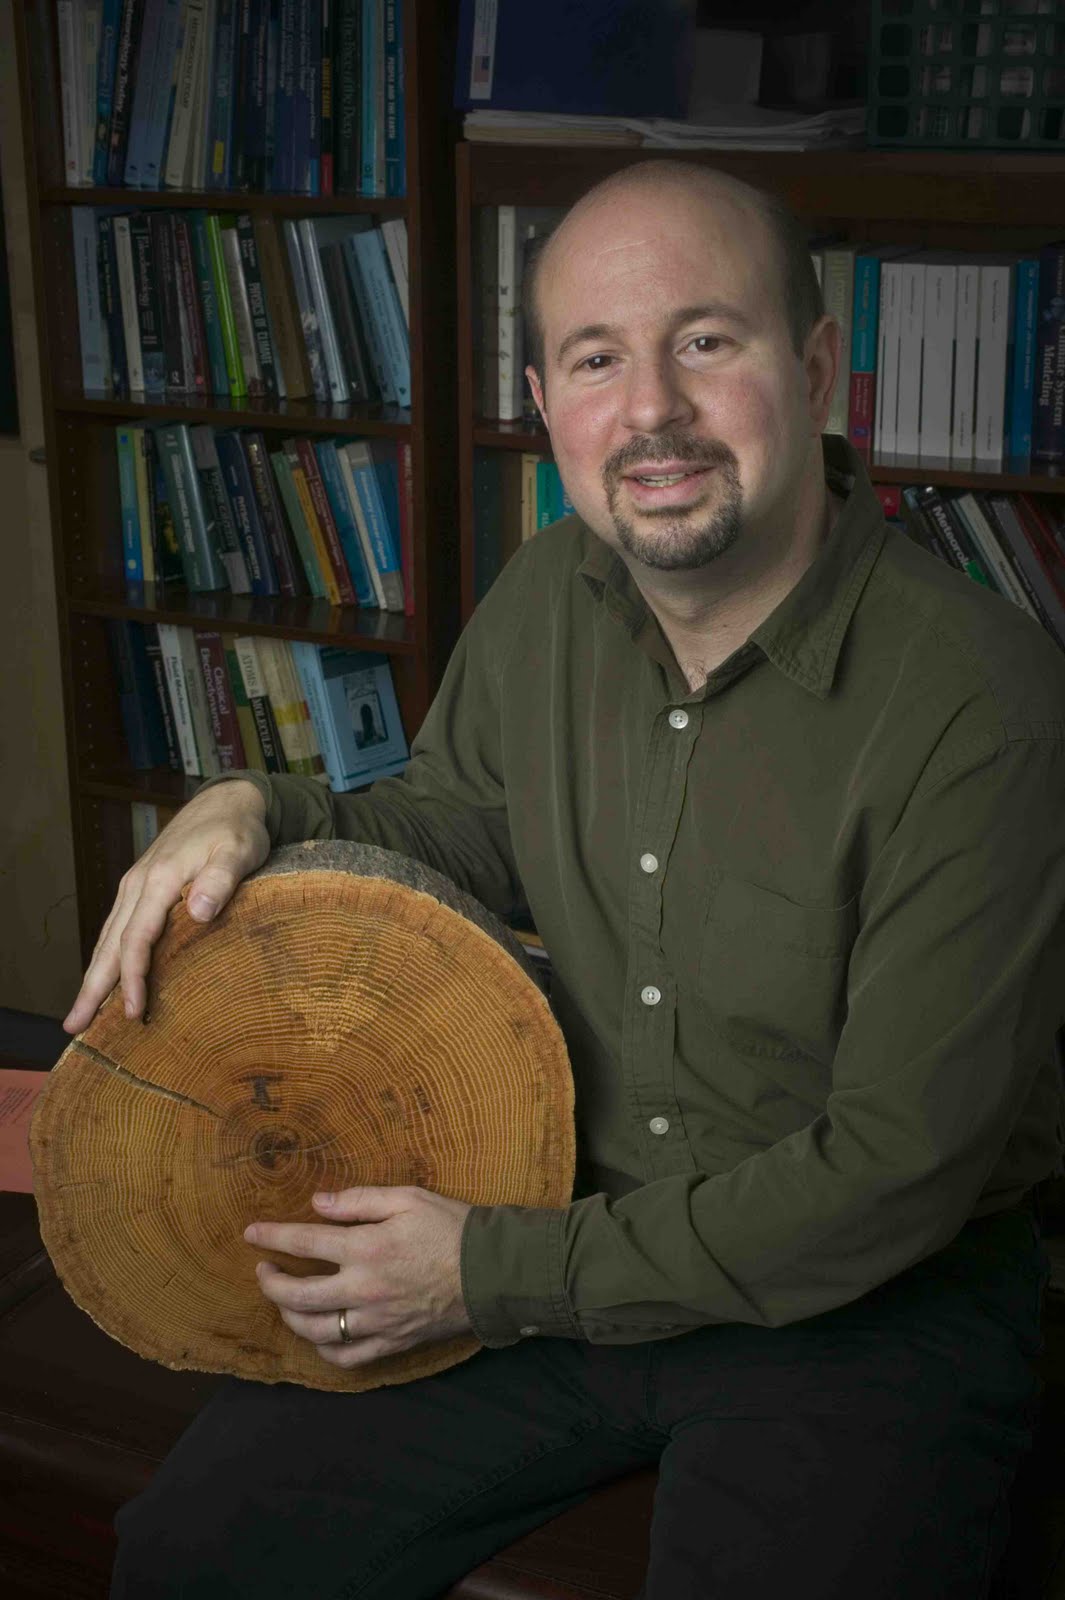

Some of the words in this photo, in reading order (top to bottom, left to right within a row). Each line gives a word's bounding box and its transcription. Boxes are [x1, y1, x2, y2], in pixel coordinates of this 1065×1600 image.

[118, 0, 136, 71] eteorology
[248, 282, 266, 316] PHYSICS
[256, 331, 273, 365] CLIMATE
[1037, 344, 1055, 407] Modeling
[1052, 379, 1065, 427] System
[200, 647, 222, 737] Electrodynamics
[213, 667, 230, 715] Classical
[240, 653, 258, 687] ATOMS
[251, 697, 270, 757] MOLECULES
